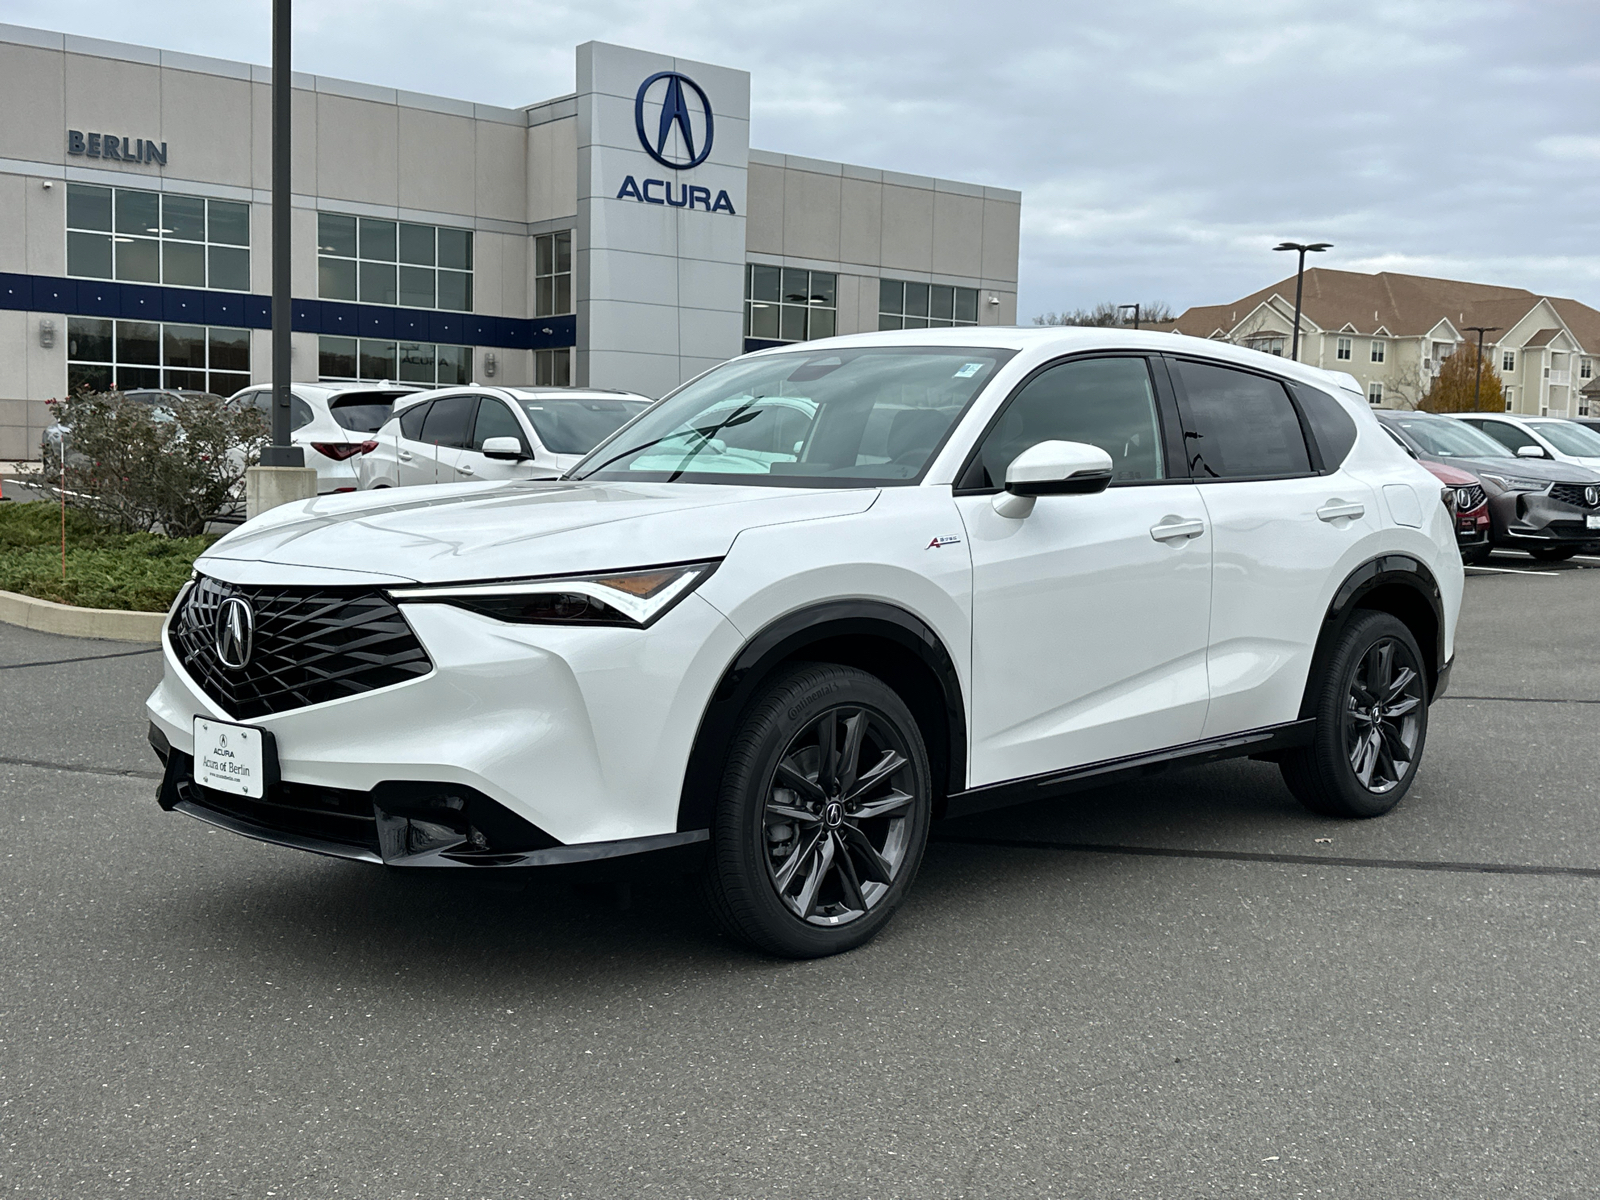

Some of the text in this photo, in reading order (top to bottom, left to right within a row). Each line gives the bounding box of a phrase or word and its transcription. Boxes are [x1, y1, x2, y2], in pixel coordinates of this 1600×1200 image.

[68, 130, 167, 166] BERLIN
[616, 175, 736, 215] ACURA
[788, 683, 833, 721] Continental
[203, 756, 250, 777] Acura of Berlin
[213, 747, 235, 758] ACURA
